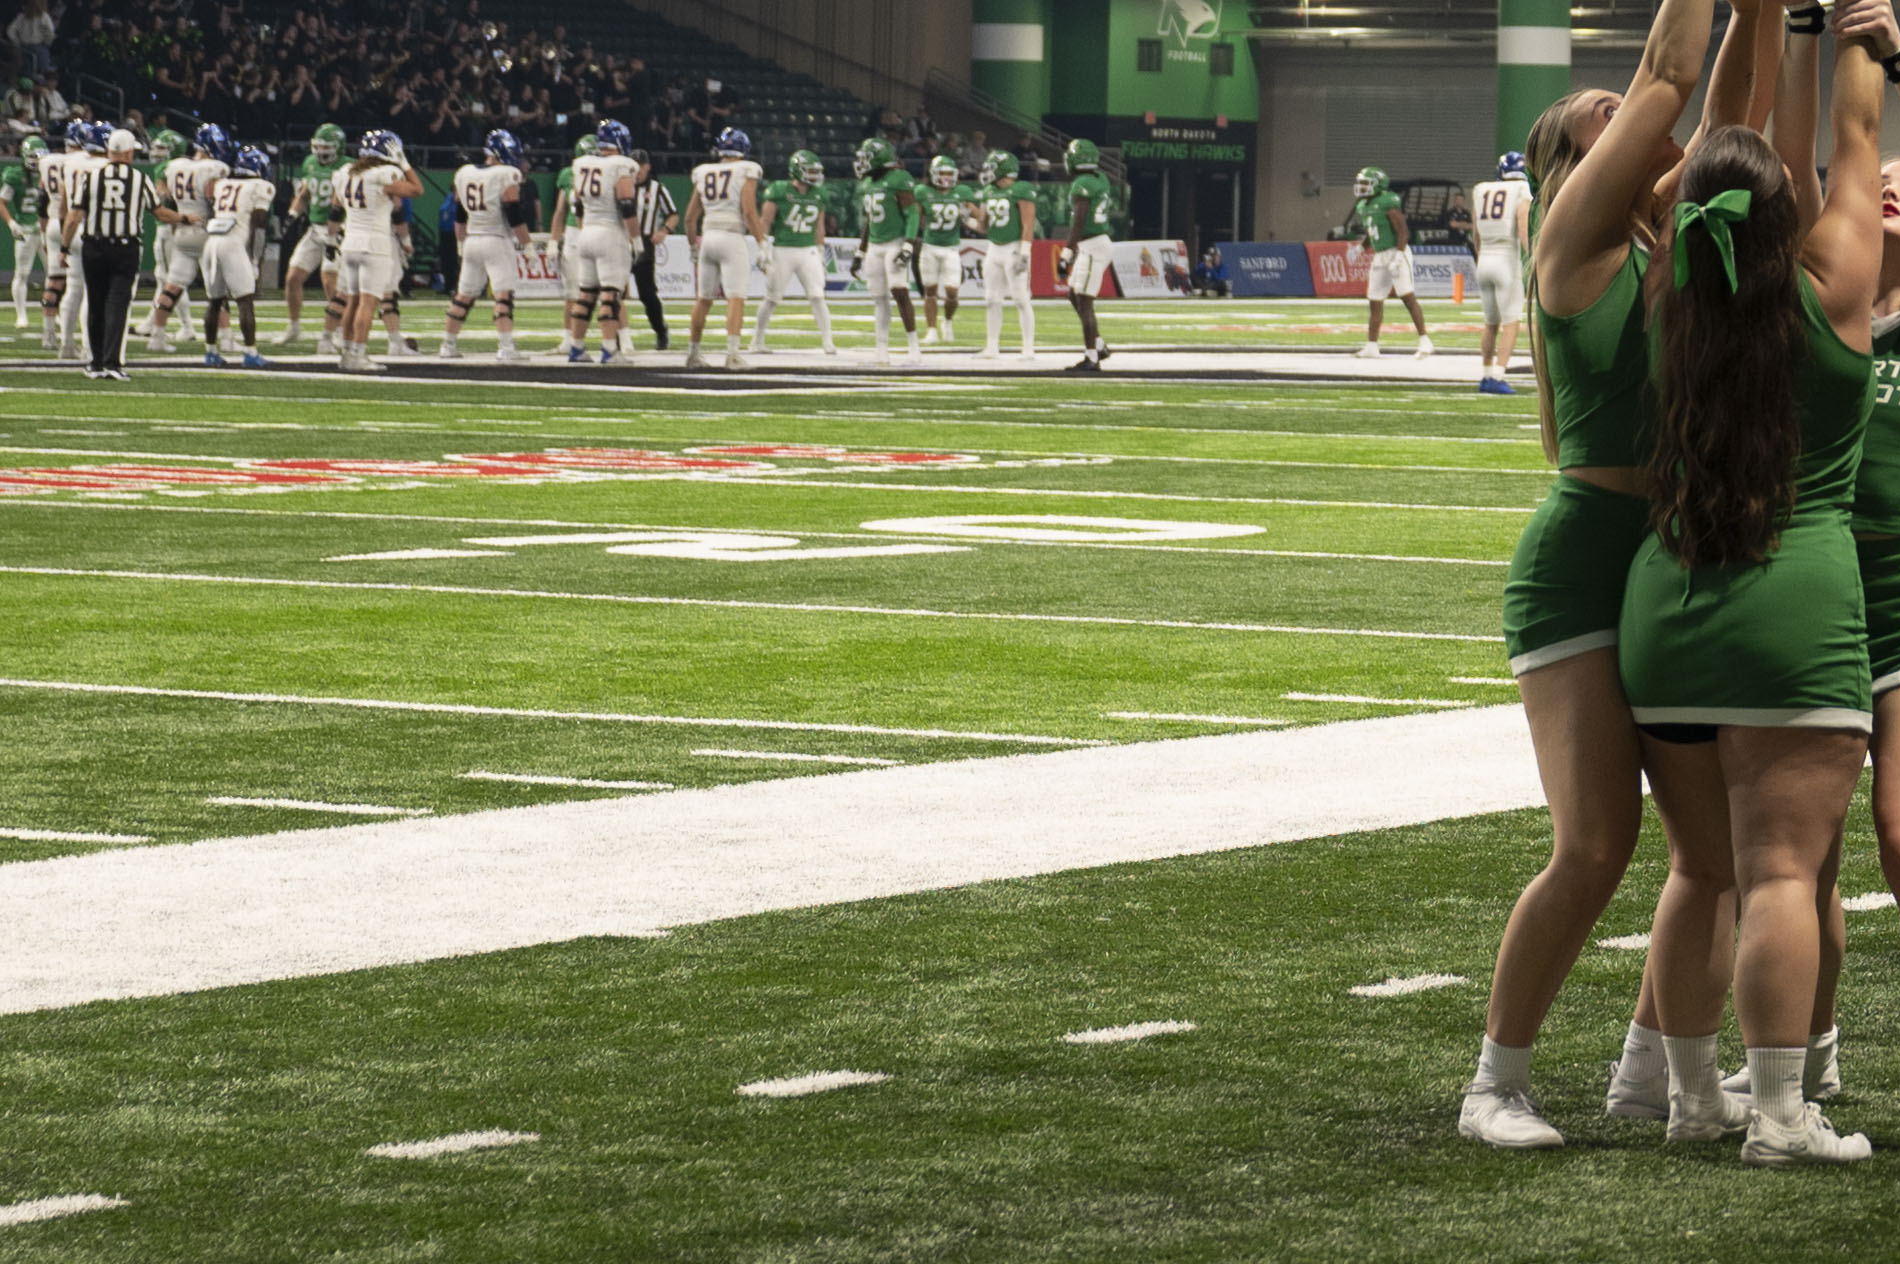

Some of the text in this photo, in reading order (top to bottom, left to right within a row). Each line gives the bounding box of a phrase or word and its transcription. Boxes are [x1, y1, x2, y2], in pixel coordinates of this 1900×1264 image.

[1168, 50, 1206, 63] FOOTBALL
[1152, 127, 1179, 139] NORTH
[1121, 140, 1246, 161] FIGHTING HAWKS
[103, 178, 126, 210] R
[174, 170, 197, 201] 64
[344, 174, 368, 208] 44
[578, 167, 603, 198] 76
[703, 169, 733, 201] 87
[218, 184, 243, 213] 21
[466, 183, 488, 212] 61
[1480, 189, 1507, 221] 18
[784, 203, 819, 233] 42
[929, 202, 960, 231] 39
[1239, 256, 1287, 271] SANFORD
